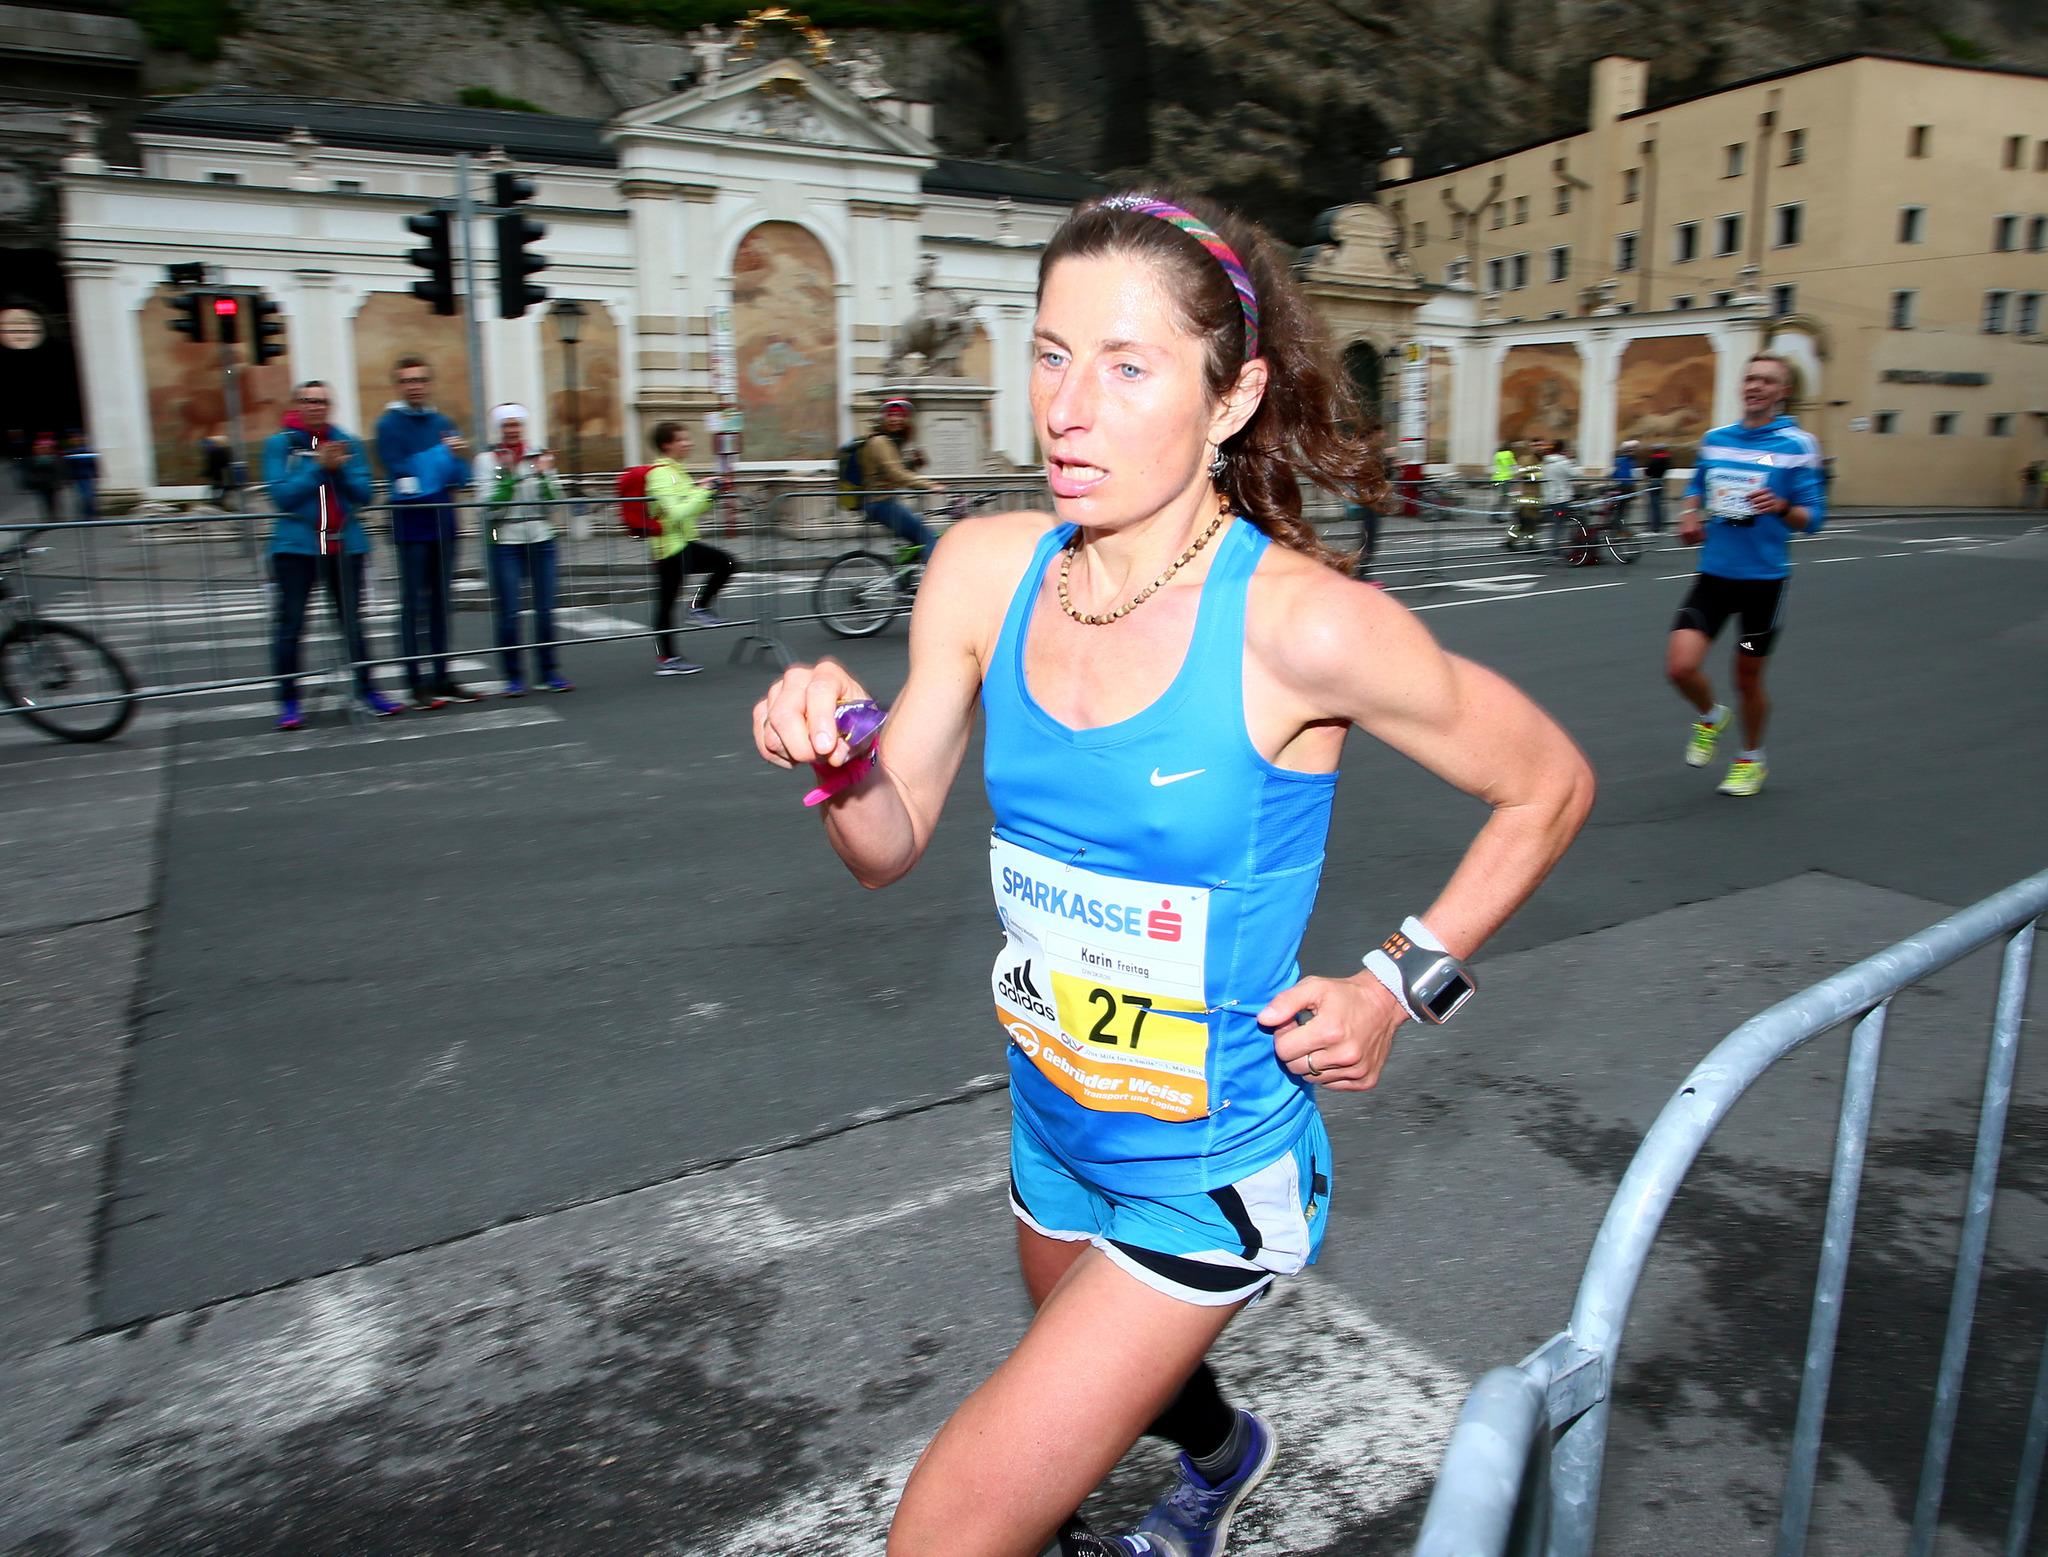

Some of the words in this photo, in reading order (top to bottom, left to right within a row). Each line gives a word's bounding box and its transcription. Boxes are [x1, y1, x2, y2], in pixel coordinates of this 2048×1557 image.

[1002, 866, 1142, 937] SPARKASSE
[1081, 947, 1112, 968] Karin
[1117, 960, 1149, 978] Freitag
[999, 981, 1055, 1021] adidas
[1088, 988, 1152, 1049] 27
[1042, 1046, 1124, 1091] Gebrüder
[1128, 1077, 1194, 1106] Weiss
[1083, 1088, 1129, 1100] Transport
[1130, 1094, 1149, 1103] und
[1151, 1098, 1188, 1114] Logistik
